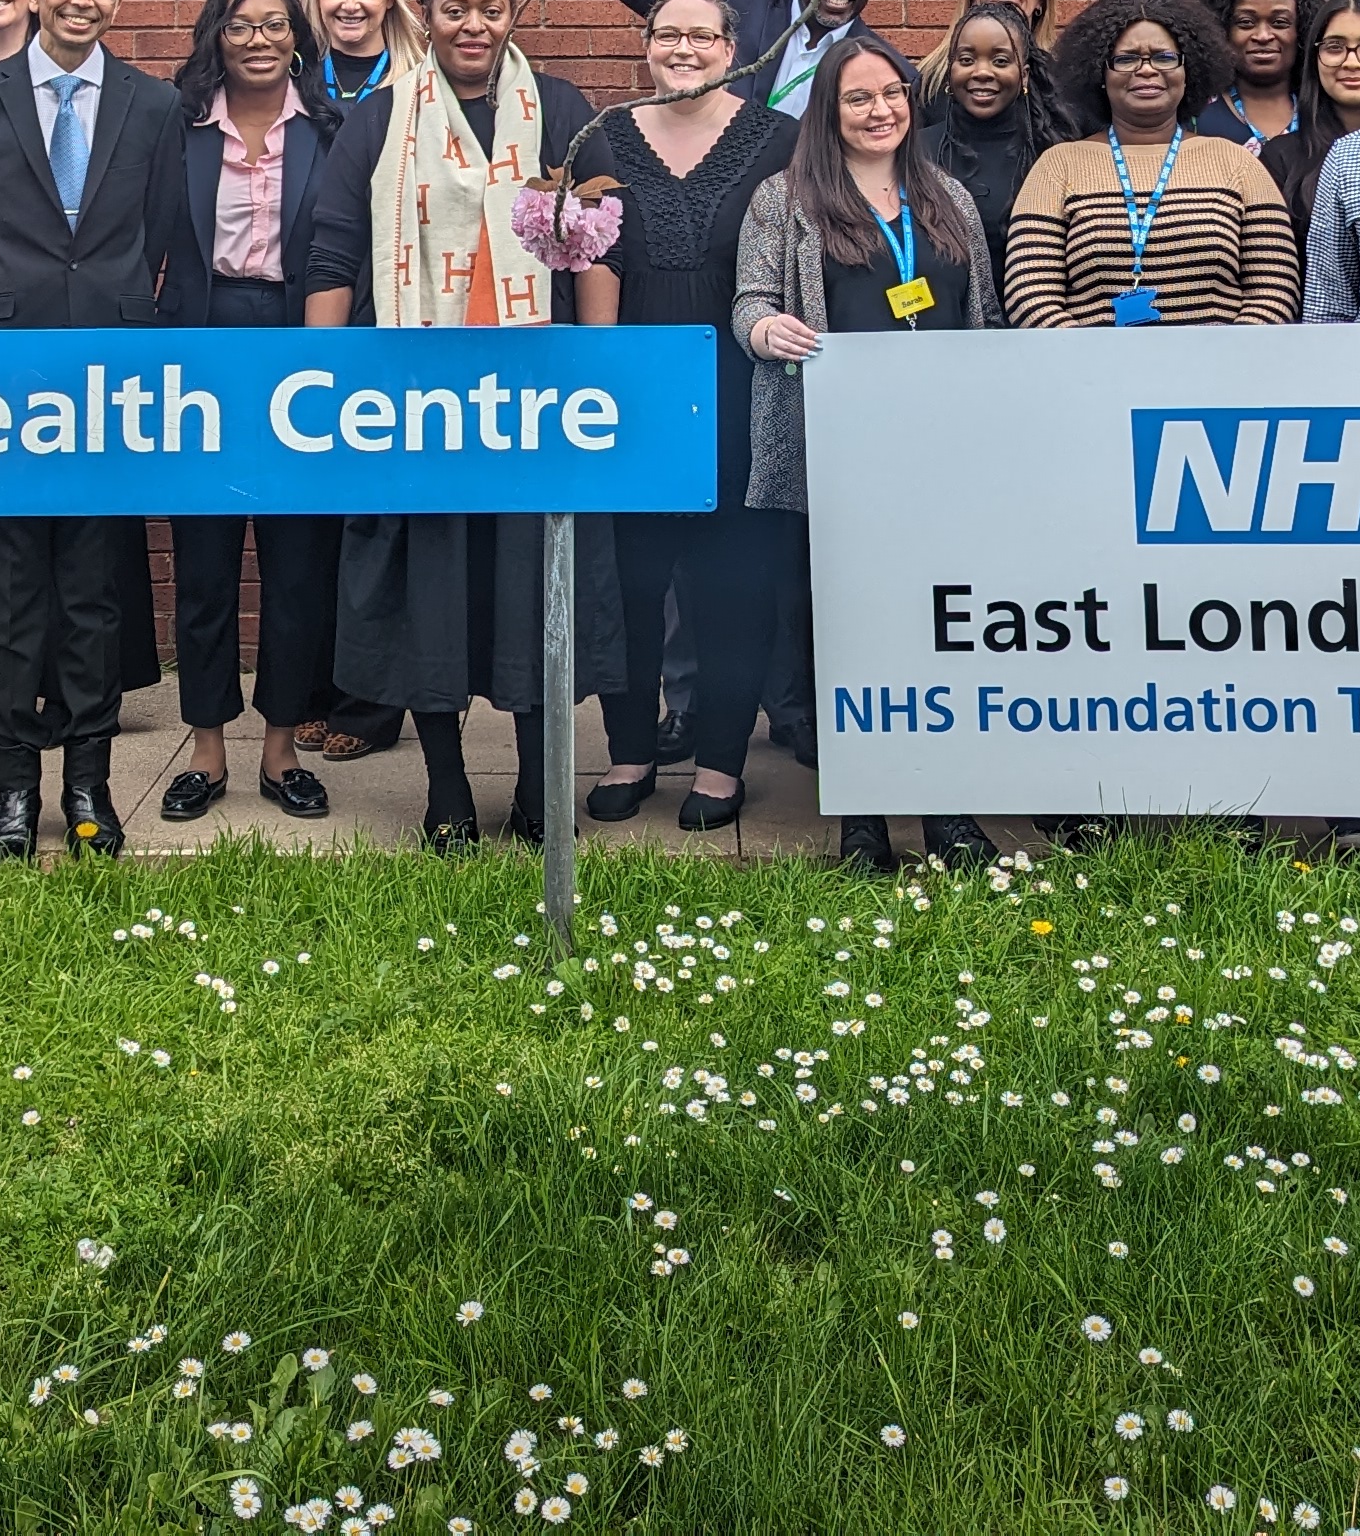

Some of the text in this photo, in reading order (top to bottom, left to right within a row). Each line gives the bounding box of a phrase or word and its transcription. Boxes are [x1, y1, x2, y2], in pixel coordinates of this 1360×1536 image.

[901, 296, 924, 308] Sarah
[269, 369, 619, 453] Centre
[932, 584, 1111, 653] East
[834, 685, 955, 734] NHS
[977, 682, 1317, 734] Foundation
